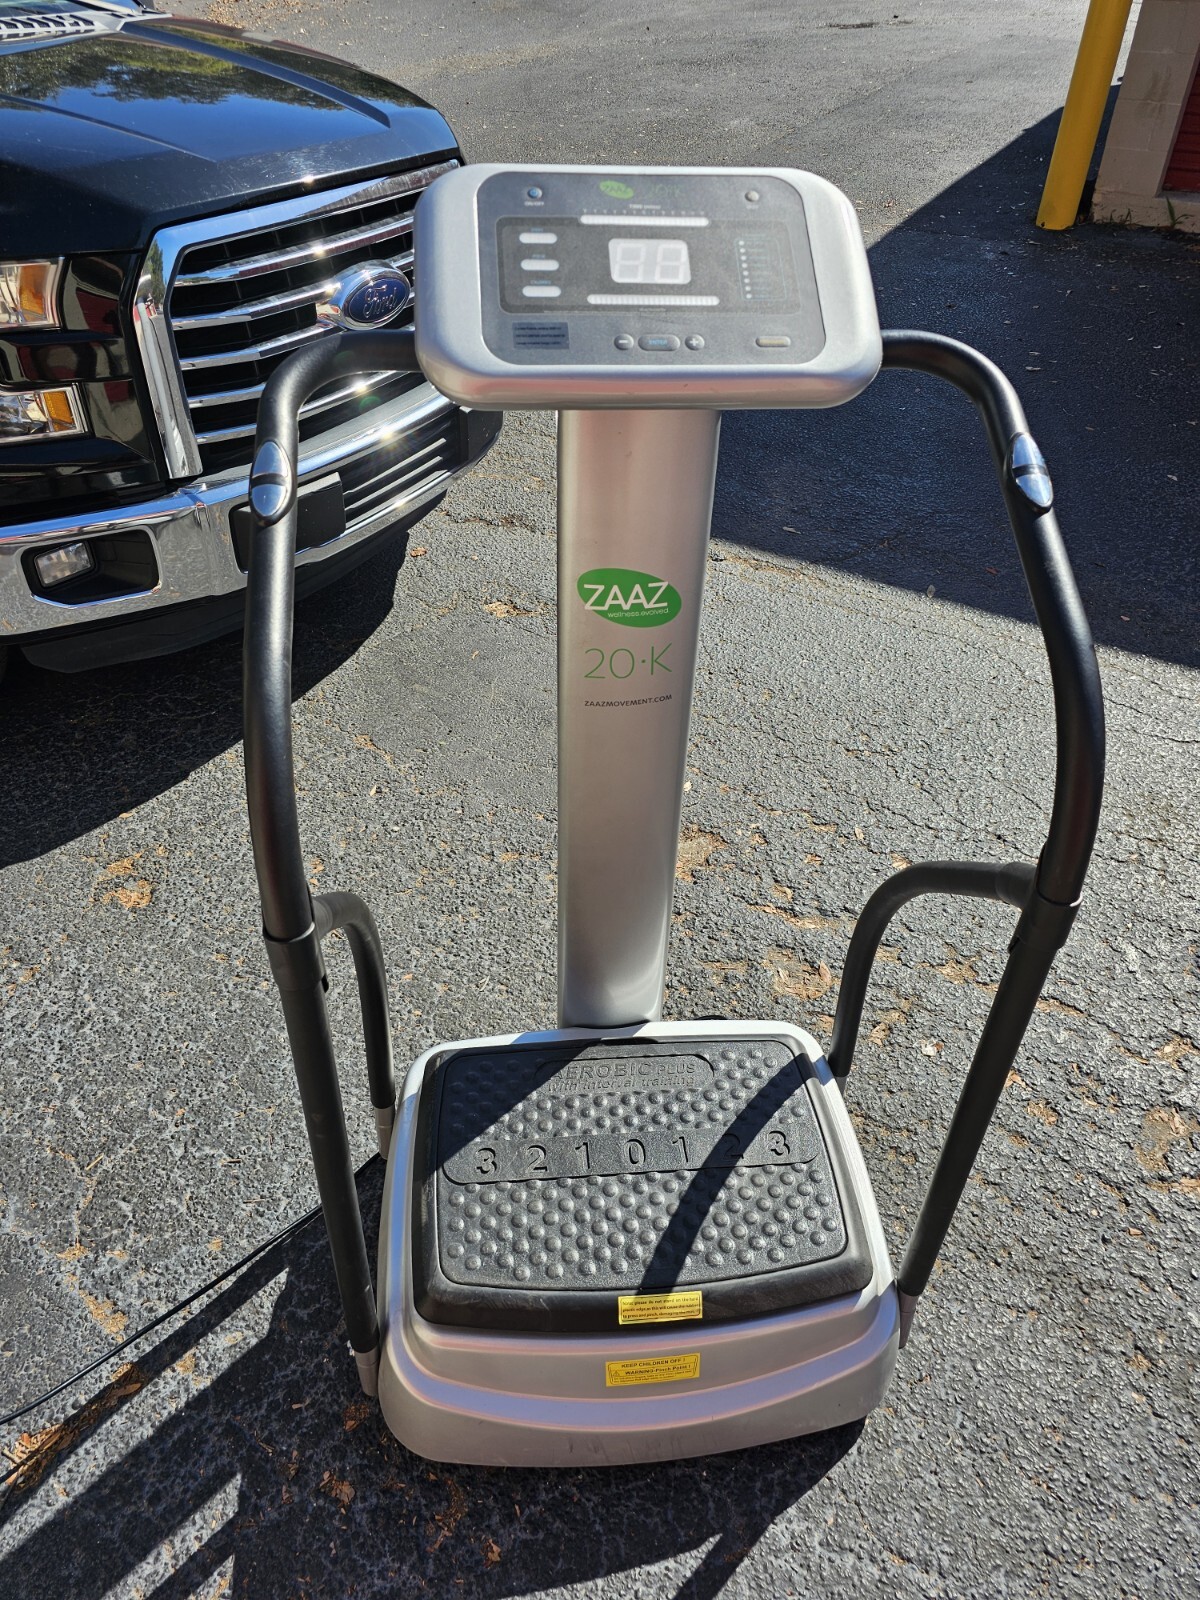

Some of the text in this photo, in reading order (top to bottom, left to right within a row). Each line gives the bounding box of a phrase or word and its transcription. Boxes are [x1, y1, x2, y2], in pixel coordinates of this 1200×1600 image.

[363, 284, 398, 318] Ford
[583, 581, 669, 611] ZAAZ
[584, 694, 673, 708] ZAAZMOVEMENT.COM
[657, 1062, 696, 1075] PLUS
[474, 1130, 791, 1175] 3 2 1 0 1 2 3
[638, 1359, 669, 1367] CHILDREN
